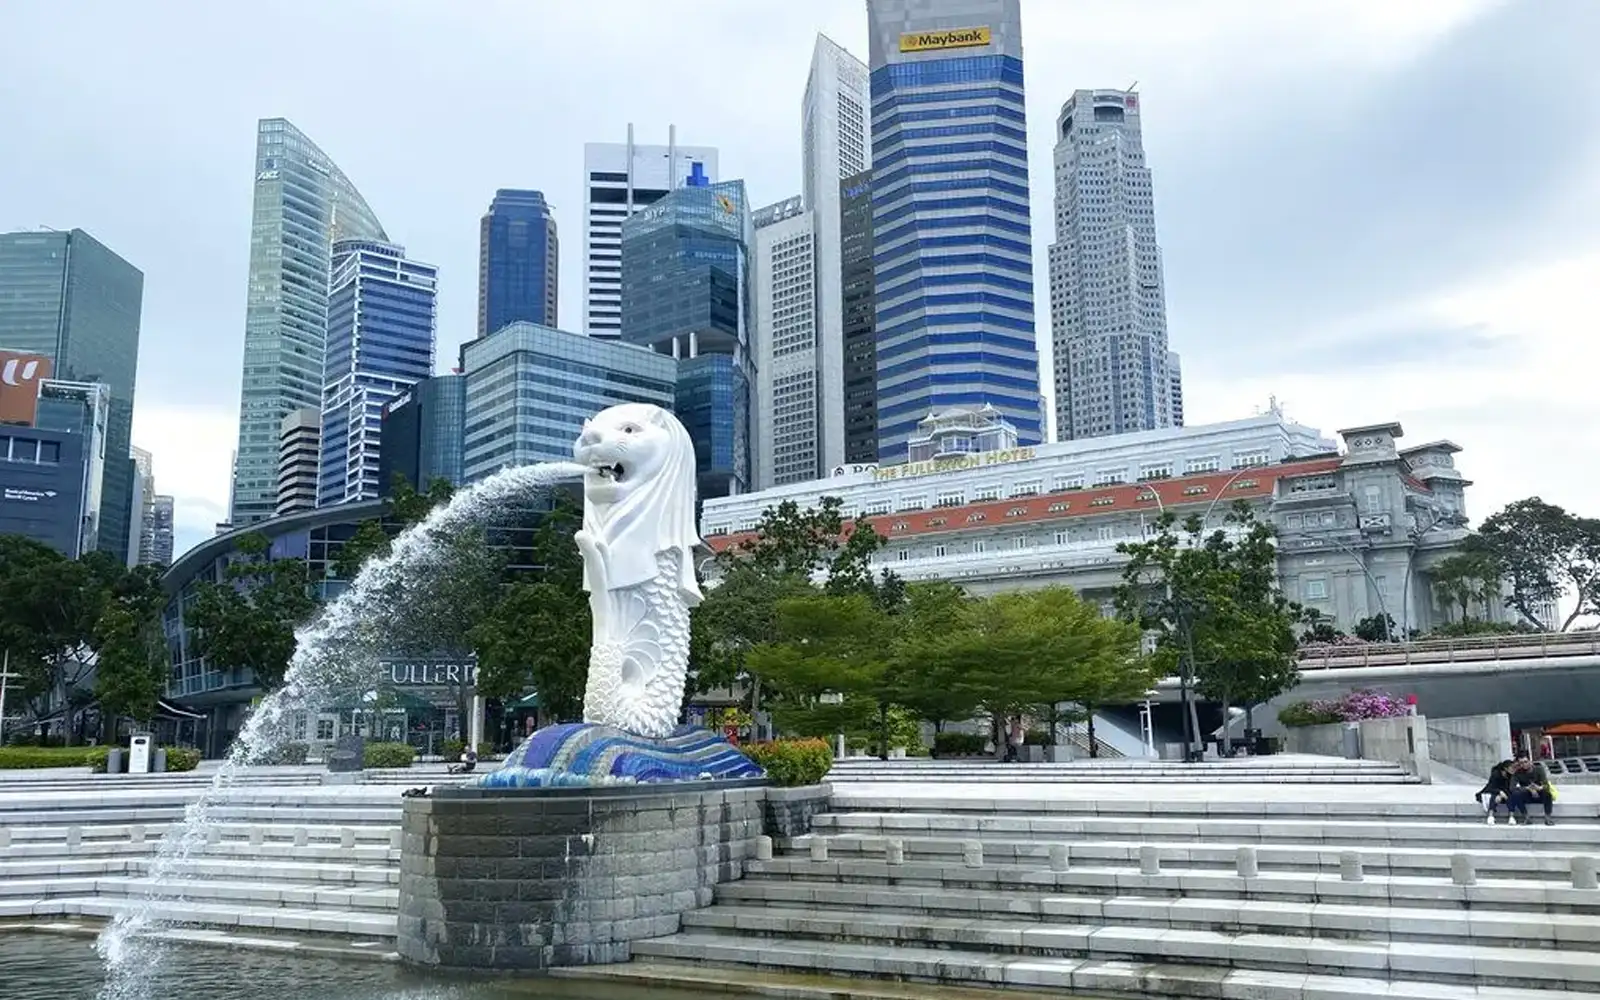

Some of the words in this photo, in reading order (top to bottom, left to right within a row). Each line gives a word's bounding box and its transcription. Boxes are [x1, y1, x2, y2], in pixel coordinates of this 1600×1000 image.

[918, 31, 982, 46] Maybank
[871, 466, 897, 481] THE
[985, 447, 1036, 465] HOTEL
